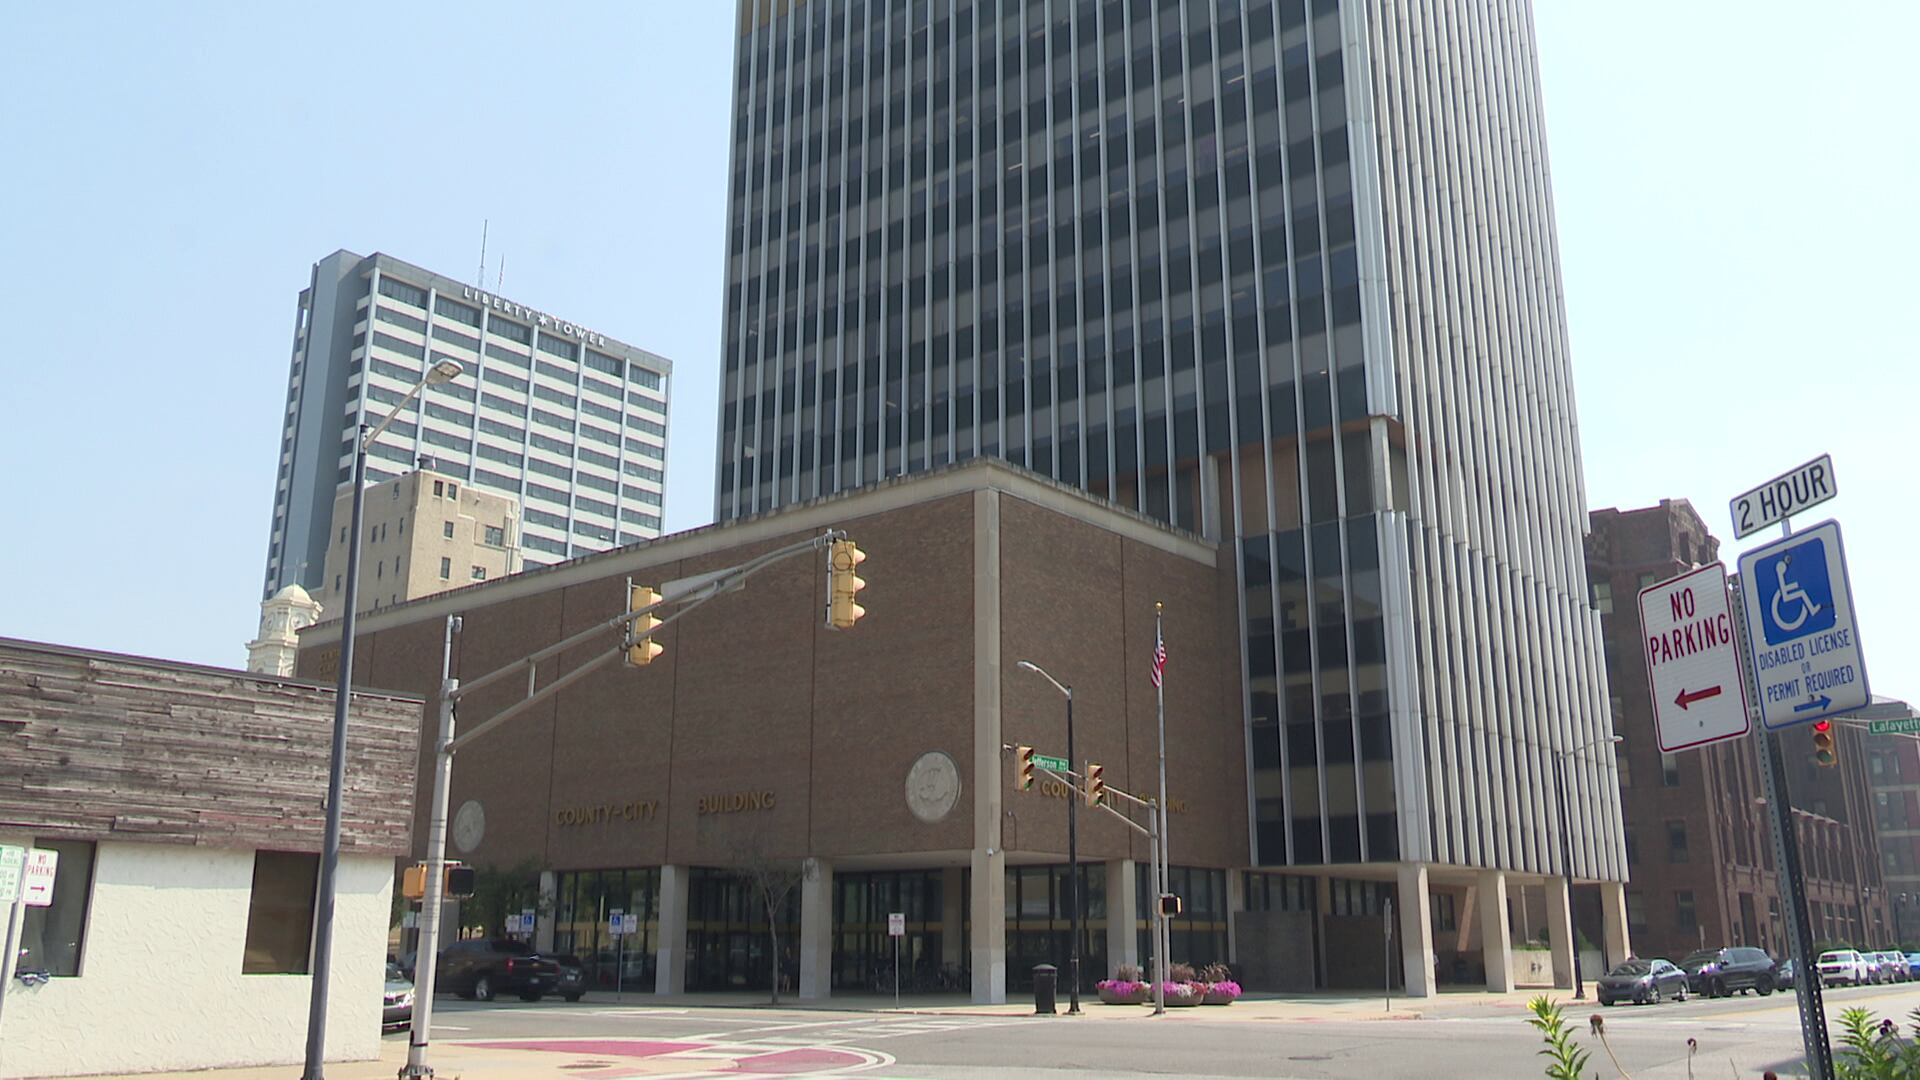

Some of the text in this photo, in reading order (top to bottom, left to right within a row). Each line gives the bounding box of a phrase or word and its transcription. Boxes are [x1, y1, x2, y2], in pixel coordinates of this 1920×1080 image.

[463, 287, 605, 348] LIBERTY TOWER
[1737, 463, 1829, 531] 2 HOUR
[1670, 587, 1695, 623] NO
[1650, 613, 1729, 667] PARKING
[1759, 629, 1851, 671] DISABLED LICENSE
[1767, 664, 1855, 703] PERMIT REQUIRED
[1801, 662, 1813, 675] OR
[1871, 718, 1920, 732] Lafayett
[555, 790, 776, 826] COUNTY-CITY BUILDING
[27, 864, 55, 878] PARKING
[38, 854, 48, 865] NO
